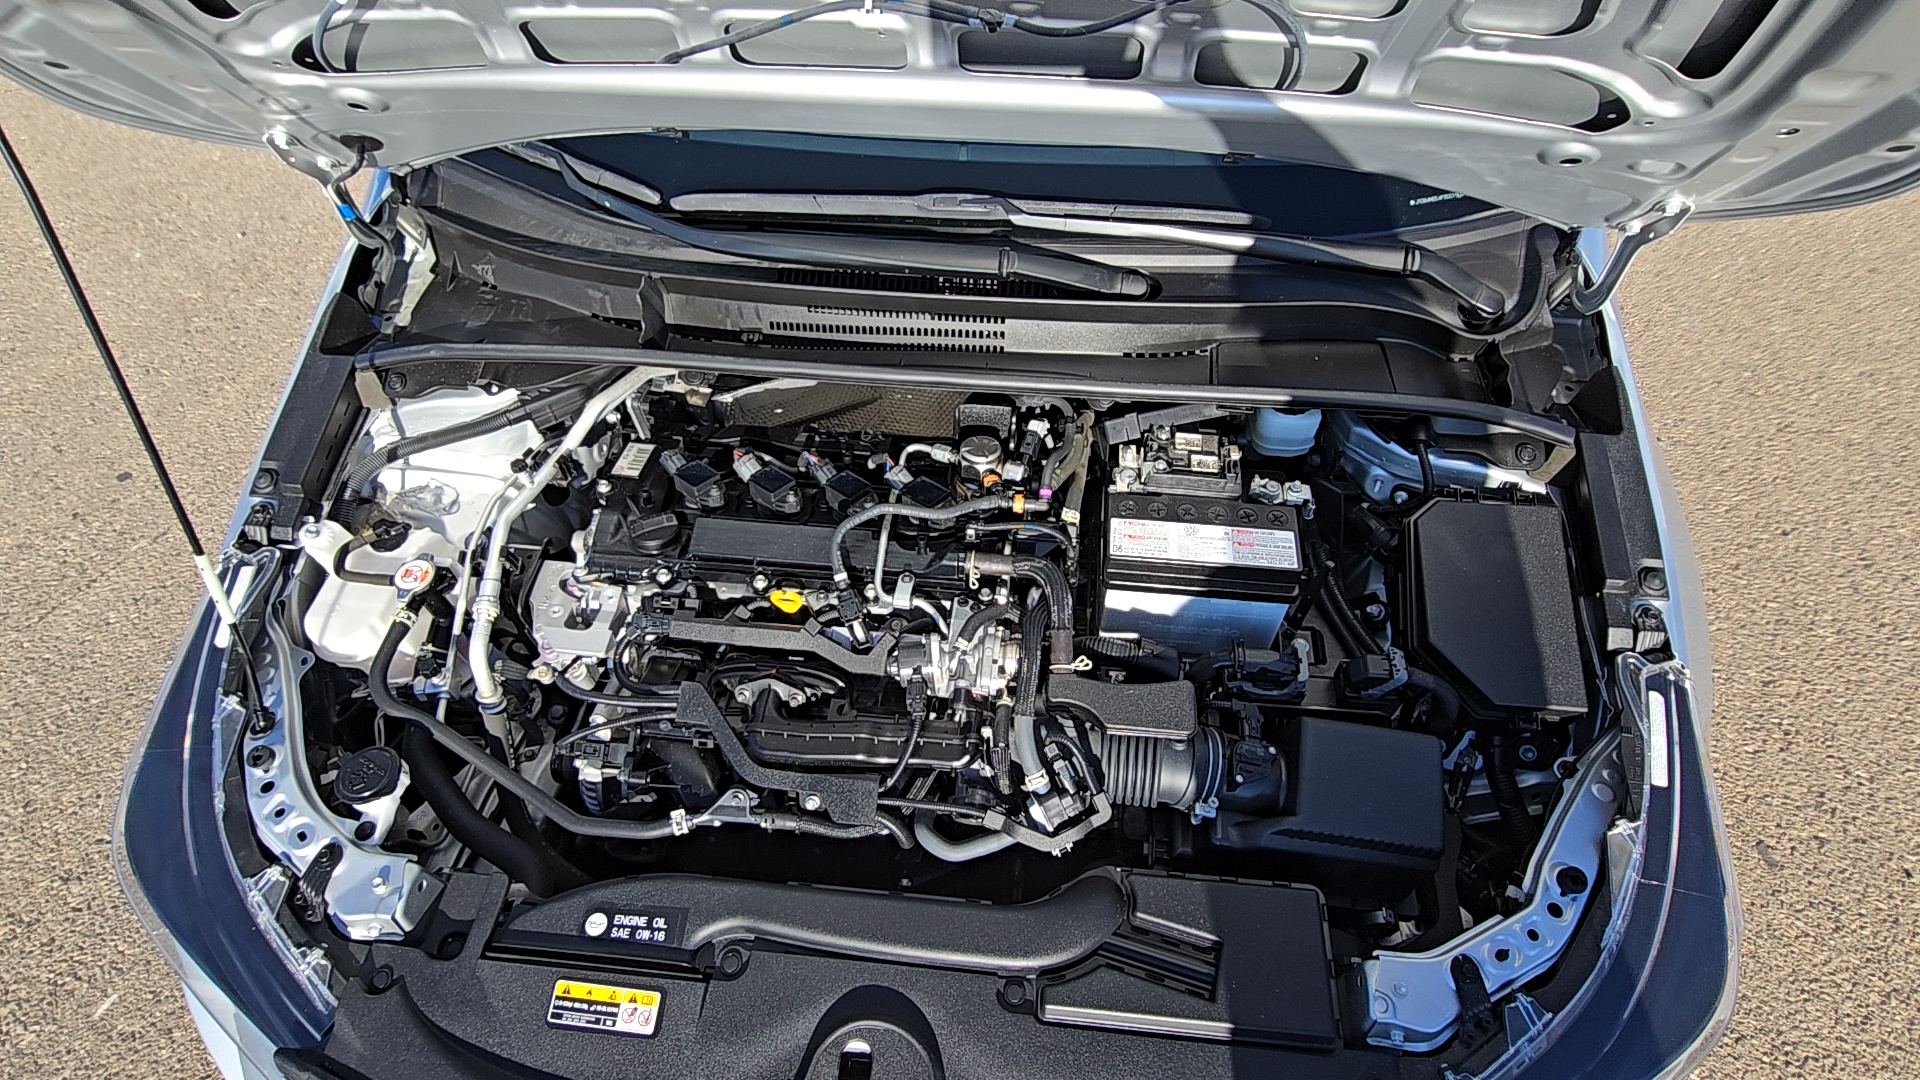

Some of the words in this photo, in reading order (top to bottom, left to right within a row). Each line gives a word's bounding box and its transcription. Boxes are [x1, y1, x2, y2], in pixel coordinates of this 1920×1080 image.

[613, 914, 648, 927] ENGINE
[652, 917, 668, 929] OIL
[610, 927, 631, 939] SAE
[635, 929, 666, 942] 0W-16
